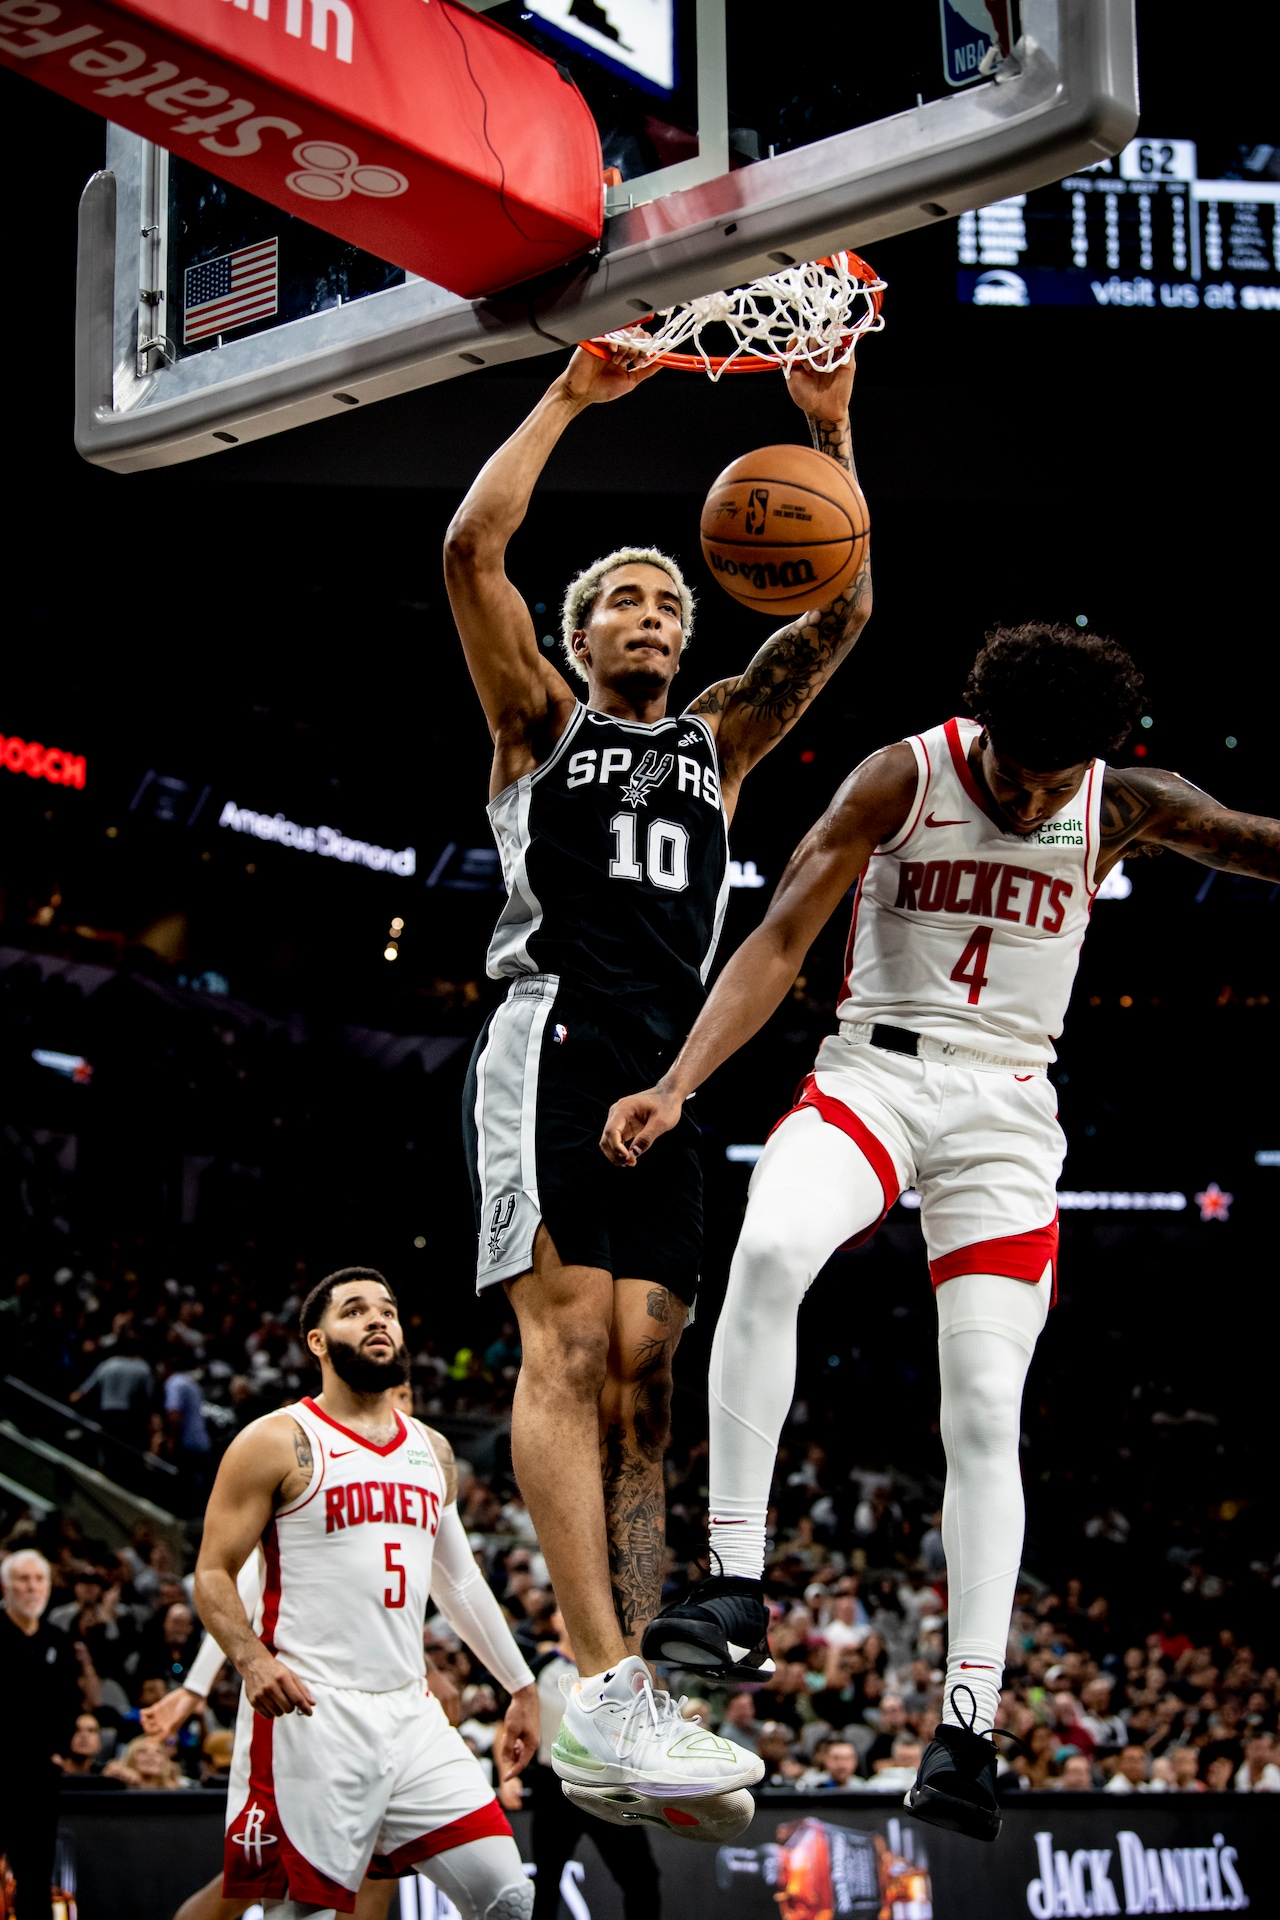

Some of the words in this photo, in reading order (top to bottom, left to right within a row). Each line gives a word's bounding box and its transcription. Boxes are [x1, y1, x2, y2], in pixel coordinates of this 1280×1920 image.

[954, 39, 988, 75] NBA
[1139, 145, 1175, 175] 62
[1090, 276, 1156, 306] visit
[1160, 284, 1199, 308] us
[1203, 281, 1237, 309] at
[708, 549, 819, 590] Wilson
[0, 732, 87, 790] OSCH
[1037, 833, 1083, 845] karma
[1040, 818, 1083, 833] credit
[608, 811, 690, 893] 10
[894, 860, 1073, 934] ROCKETS
[950, 925, 994, 1006] 4
[326, 1481, 440, 1537] ROCKETS
[384, 1542, 406, 1609] 5
